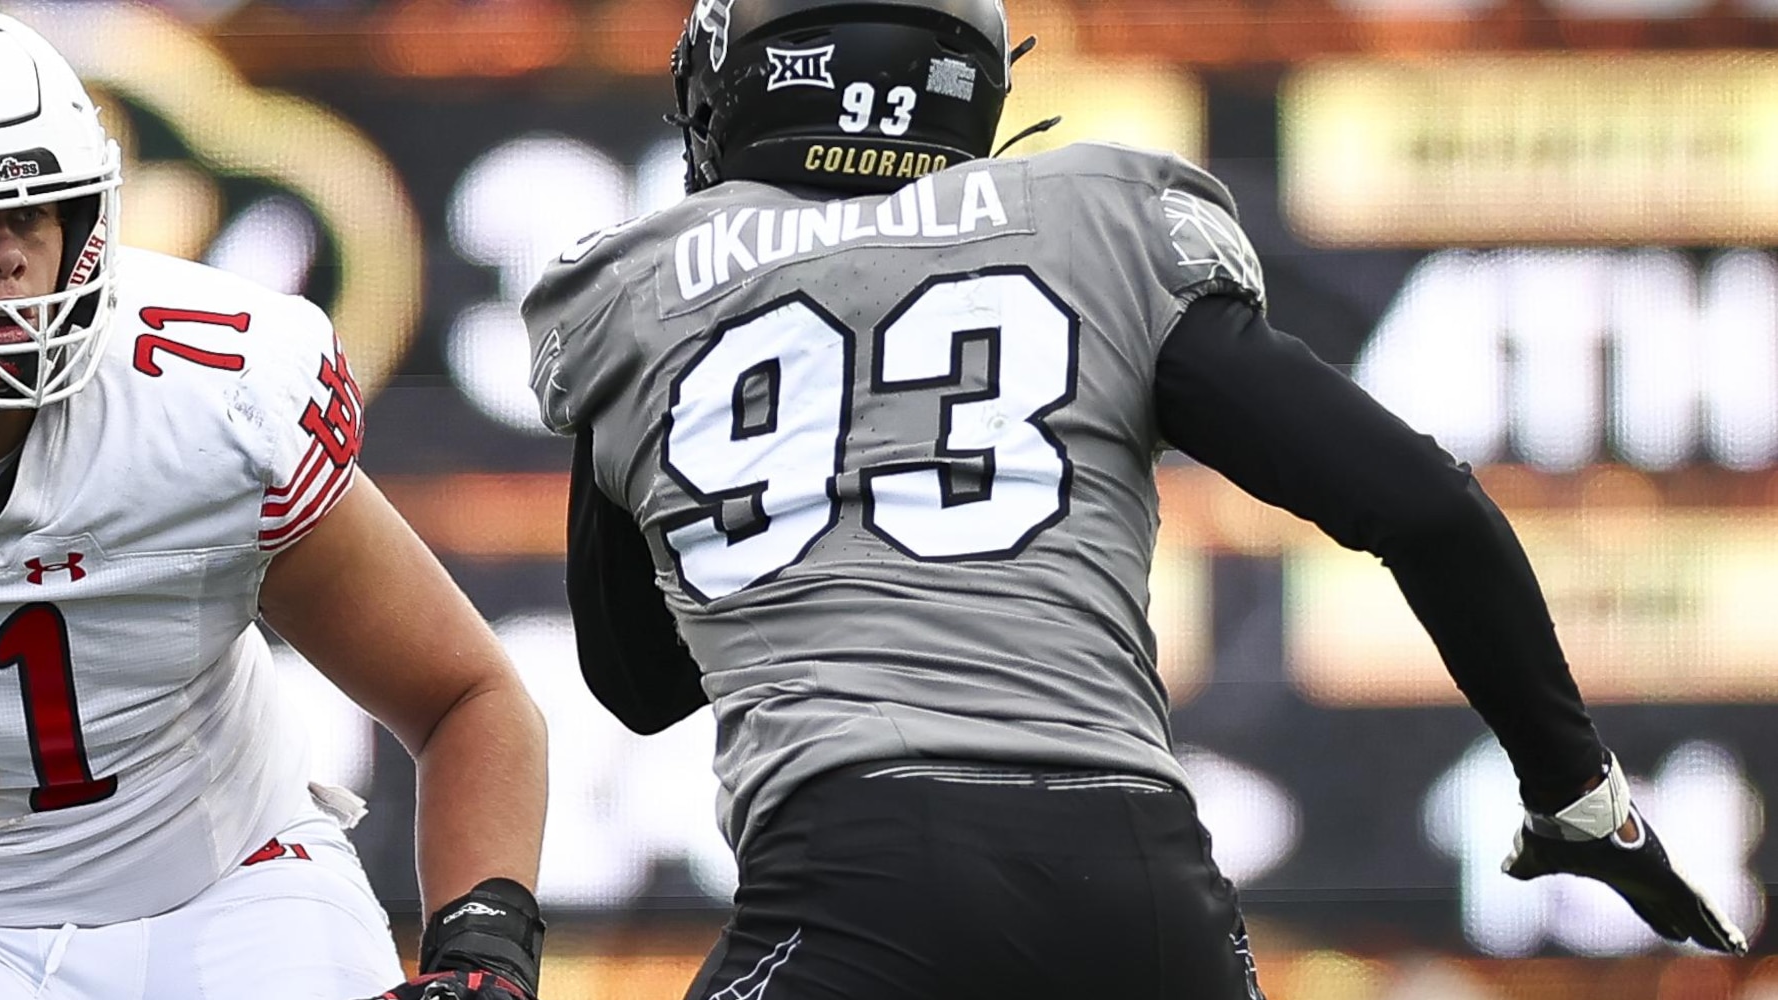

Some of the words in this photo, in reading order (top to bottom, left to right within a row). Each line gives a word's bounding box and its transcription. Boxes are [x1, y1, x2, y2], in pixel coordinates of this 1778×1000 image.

[838, 82, 917, 136] 93
[805, 145, 948, 179] COLORADO
[70, 233, 105, 286] UTAH
[133, 306, 251, 377] 71
[661, 265, 1079, 605] 93
